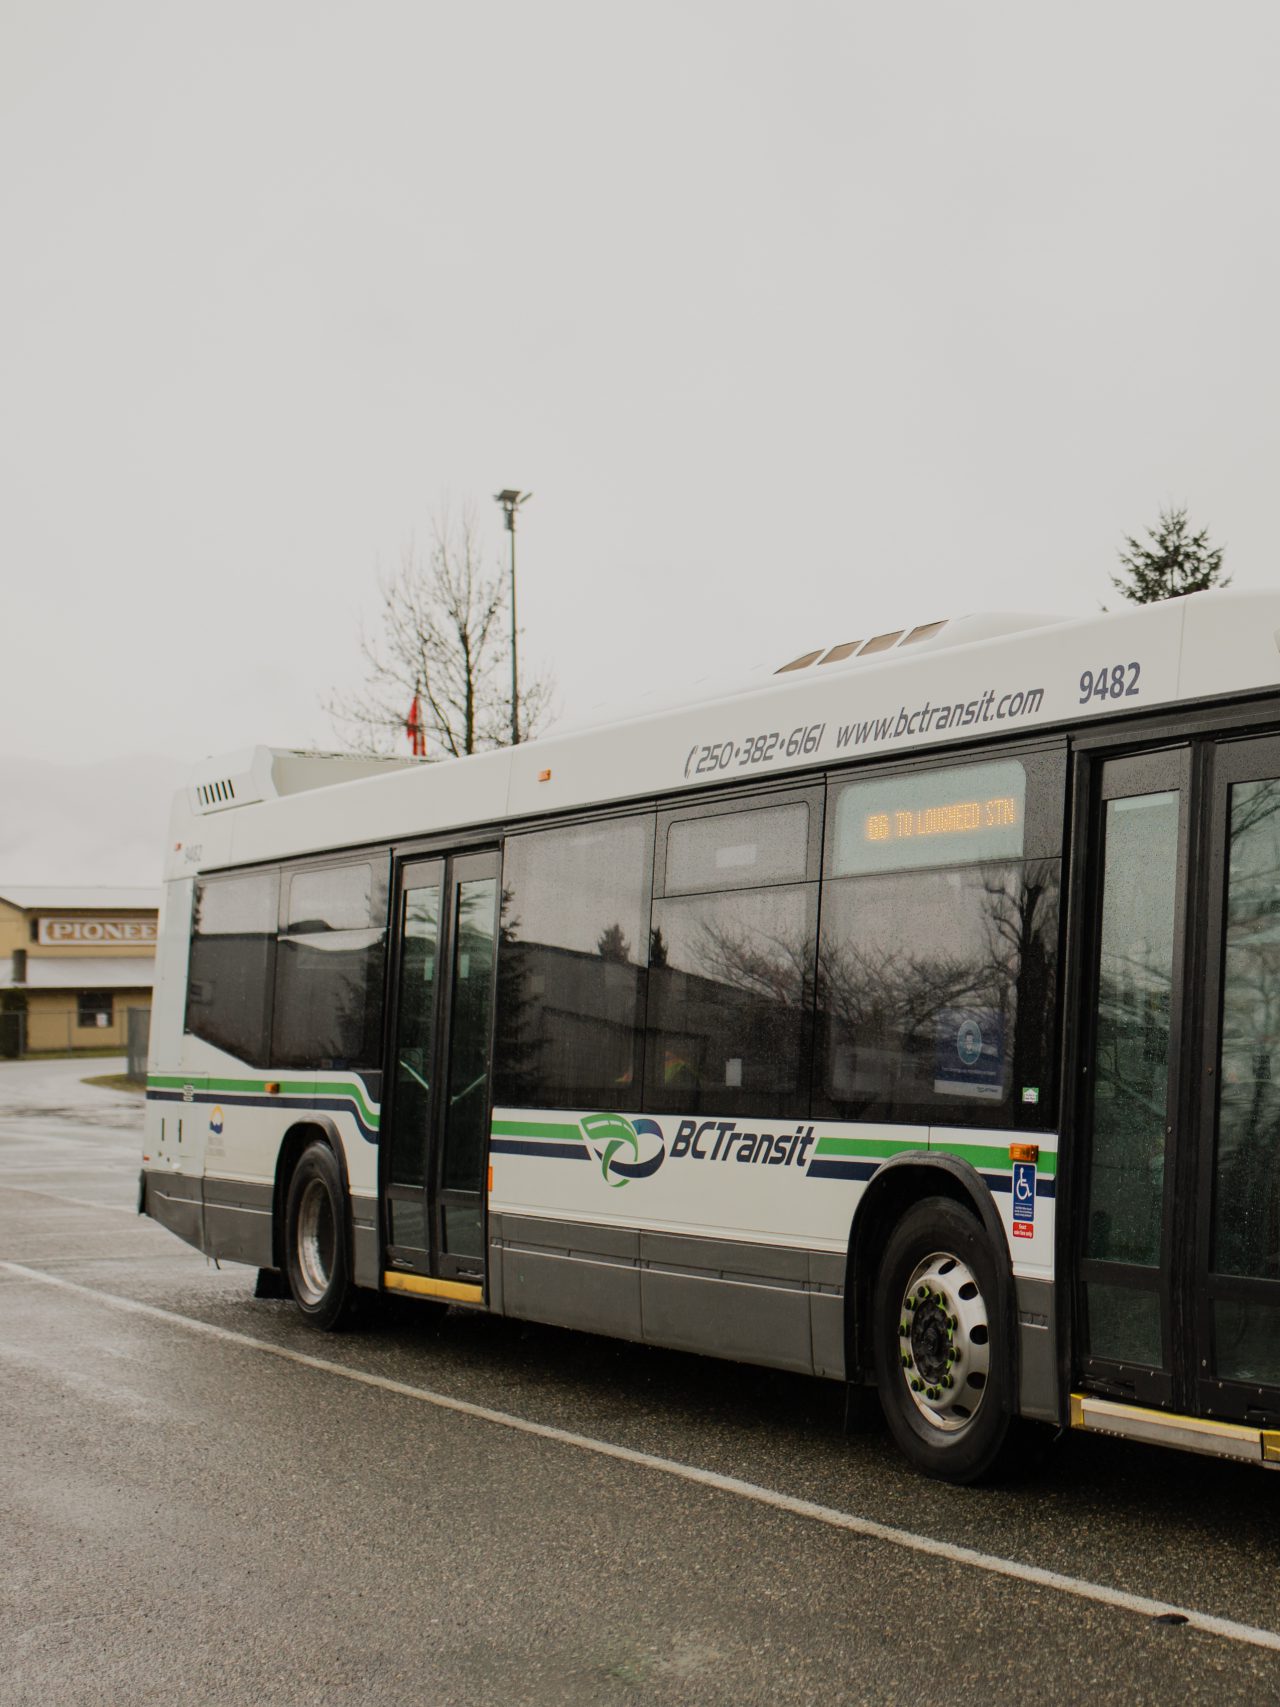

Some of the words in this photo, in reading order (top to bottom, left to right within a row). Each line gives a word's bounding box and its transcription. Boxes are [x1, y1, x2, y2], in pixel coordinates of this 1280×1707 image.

[1079, 662, 1141, 704] 9482
[836, 688, 1045, 748] www.bctransit.com
[896, 812, 913, 837] TO
[916, 802, 980, 834] LOUGHEED
[986, 799, 1015, 826] STN
